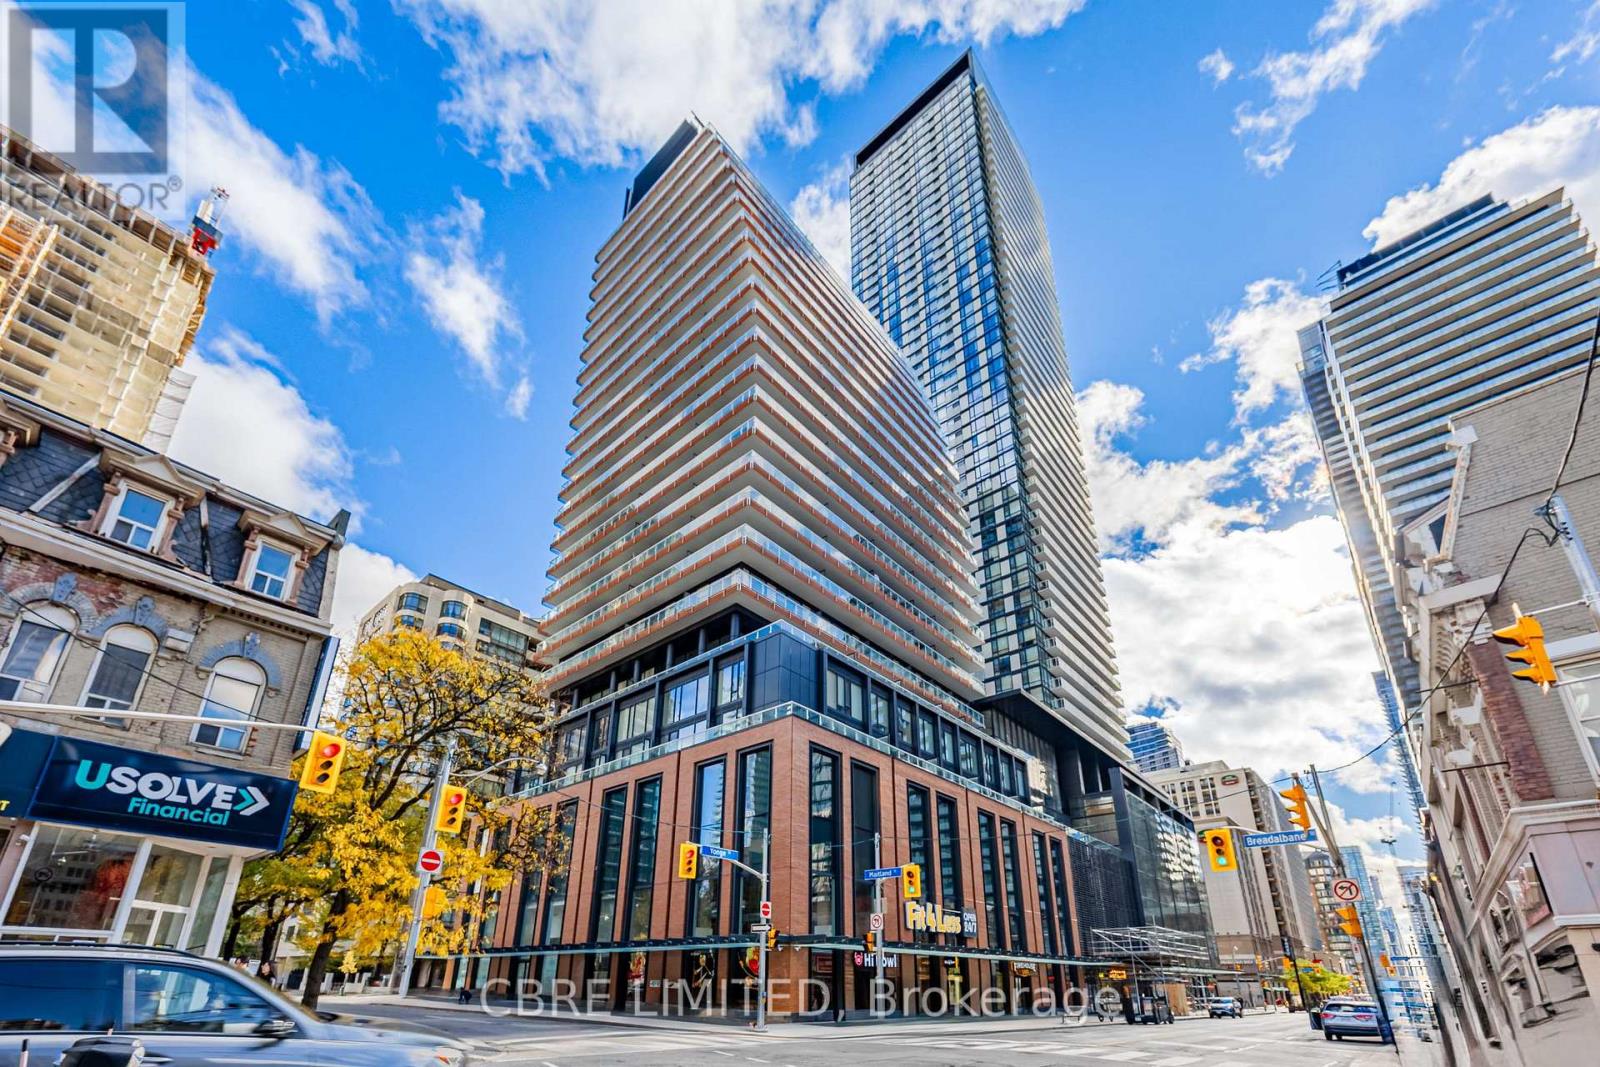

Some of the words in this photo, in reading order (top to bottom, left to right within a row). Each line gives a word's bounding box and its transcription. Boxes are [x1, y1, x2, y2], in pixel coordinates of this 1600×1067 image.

[75, 760, 238, 810] USOLVE
[128, 796, 230, 826] Financial
[1246, 834, 1306, 846] Breadalbane
